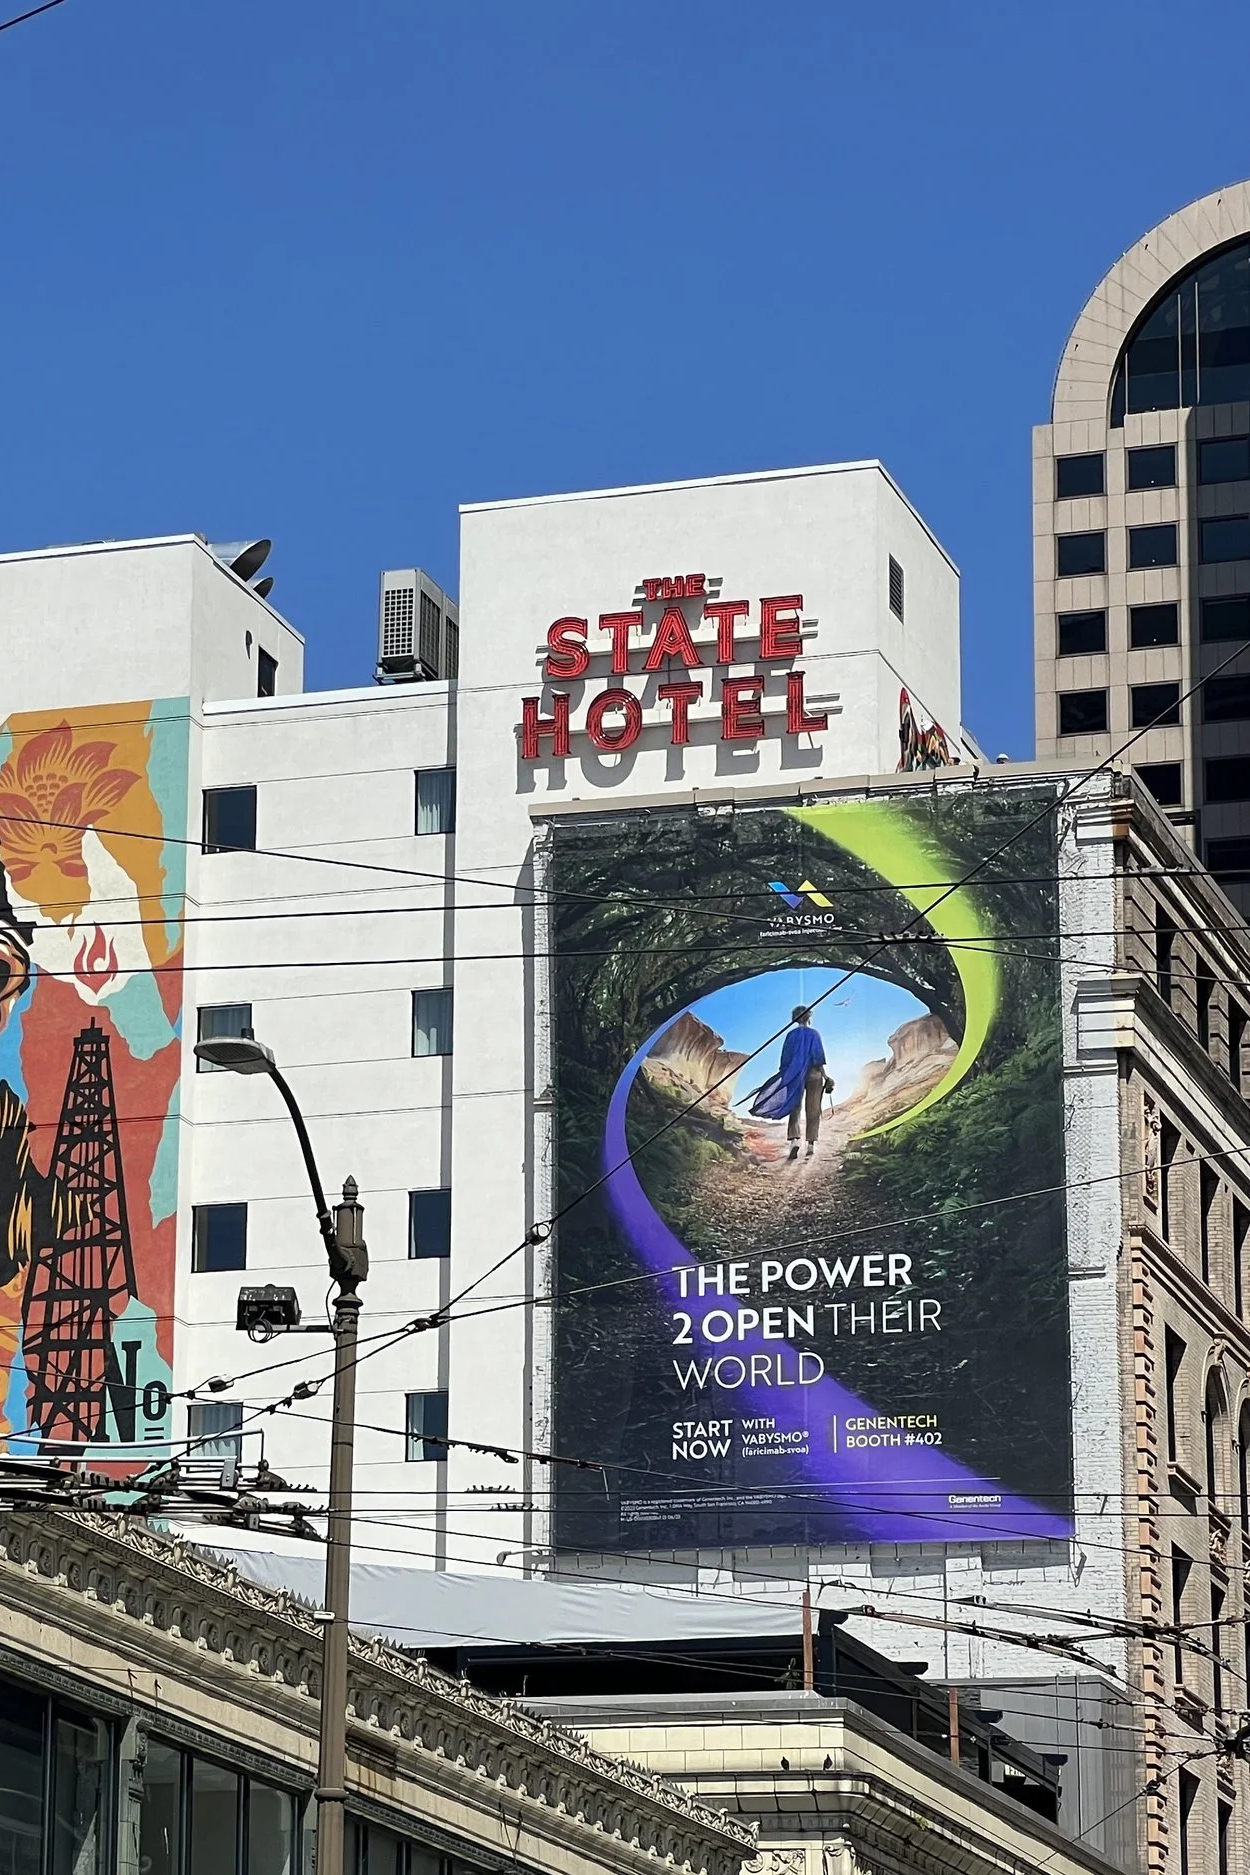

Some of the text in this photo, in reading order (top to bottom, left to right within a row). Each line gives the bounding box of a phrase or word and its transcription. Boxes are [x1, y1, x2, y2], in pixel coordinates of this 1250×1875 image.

[642, 573, 706, 601] THE
[546, 594, 803, 679] STATE
[521, 671, 829, 760] HOTEL
[672, 1253, 913, 1298] THE POWER
[672, 1299, 942, 1345] 2 OPEN THEIR
[672, 1352, 825, 1391] WORLD
[672, 1419, 733, 1440] START
[741, 1418, 775, 1430] WITH
[845, 1415, 938, 1431] GENENTECH
[672, 1439, 732, 1461] NOW
[846, 1432, 943, 1448] BOOTH #402
[948, 1494, 1002, 1504] Genentech
